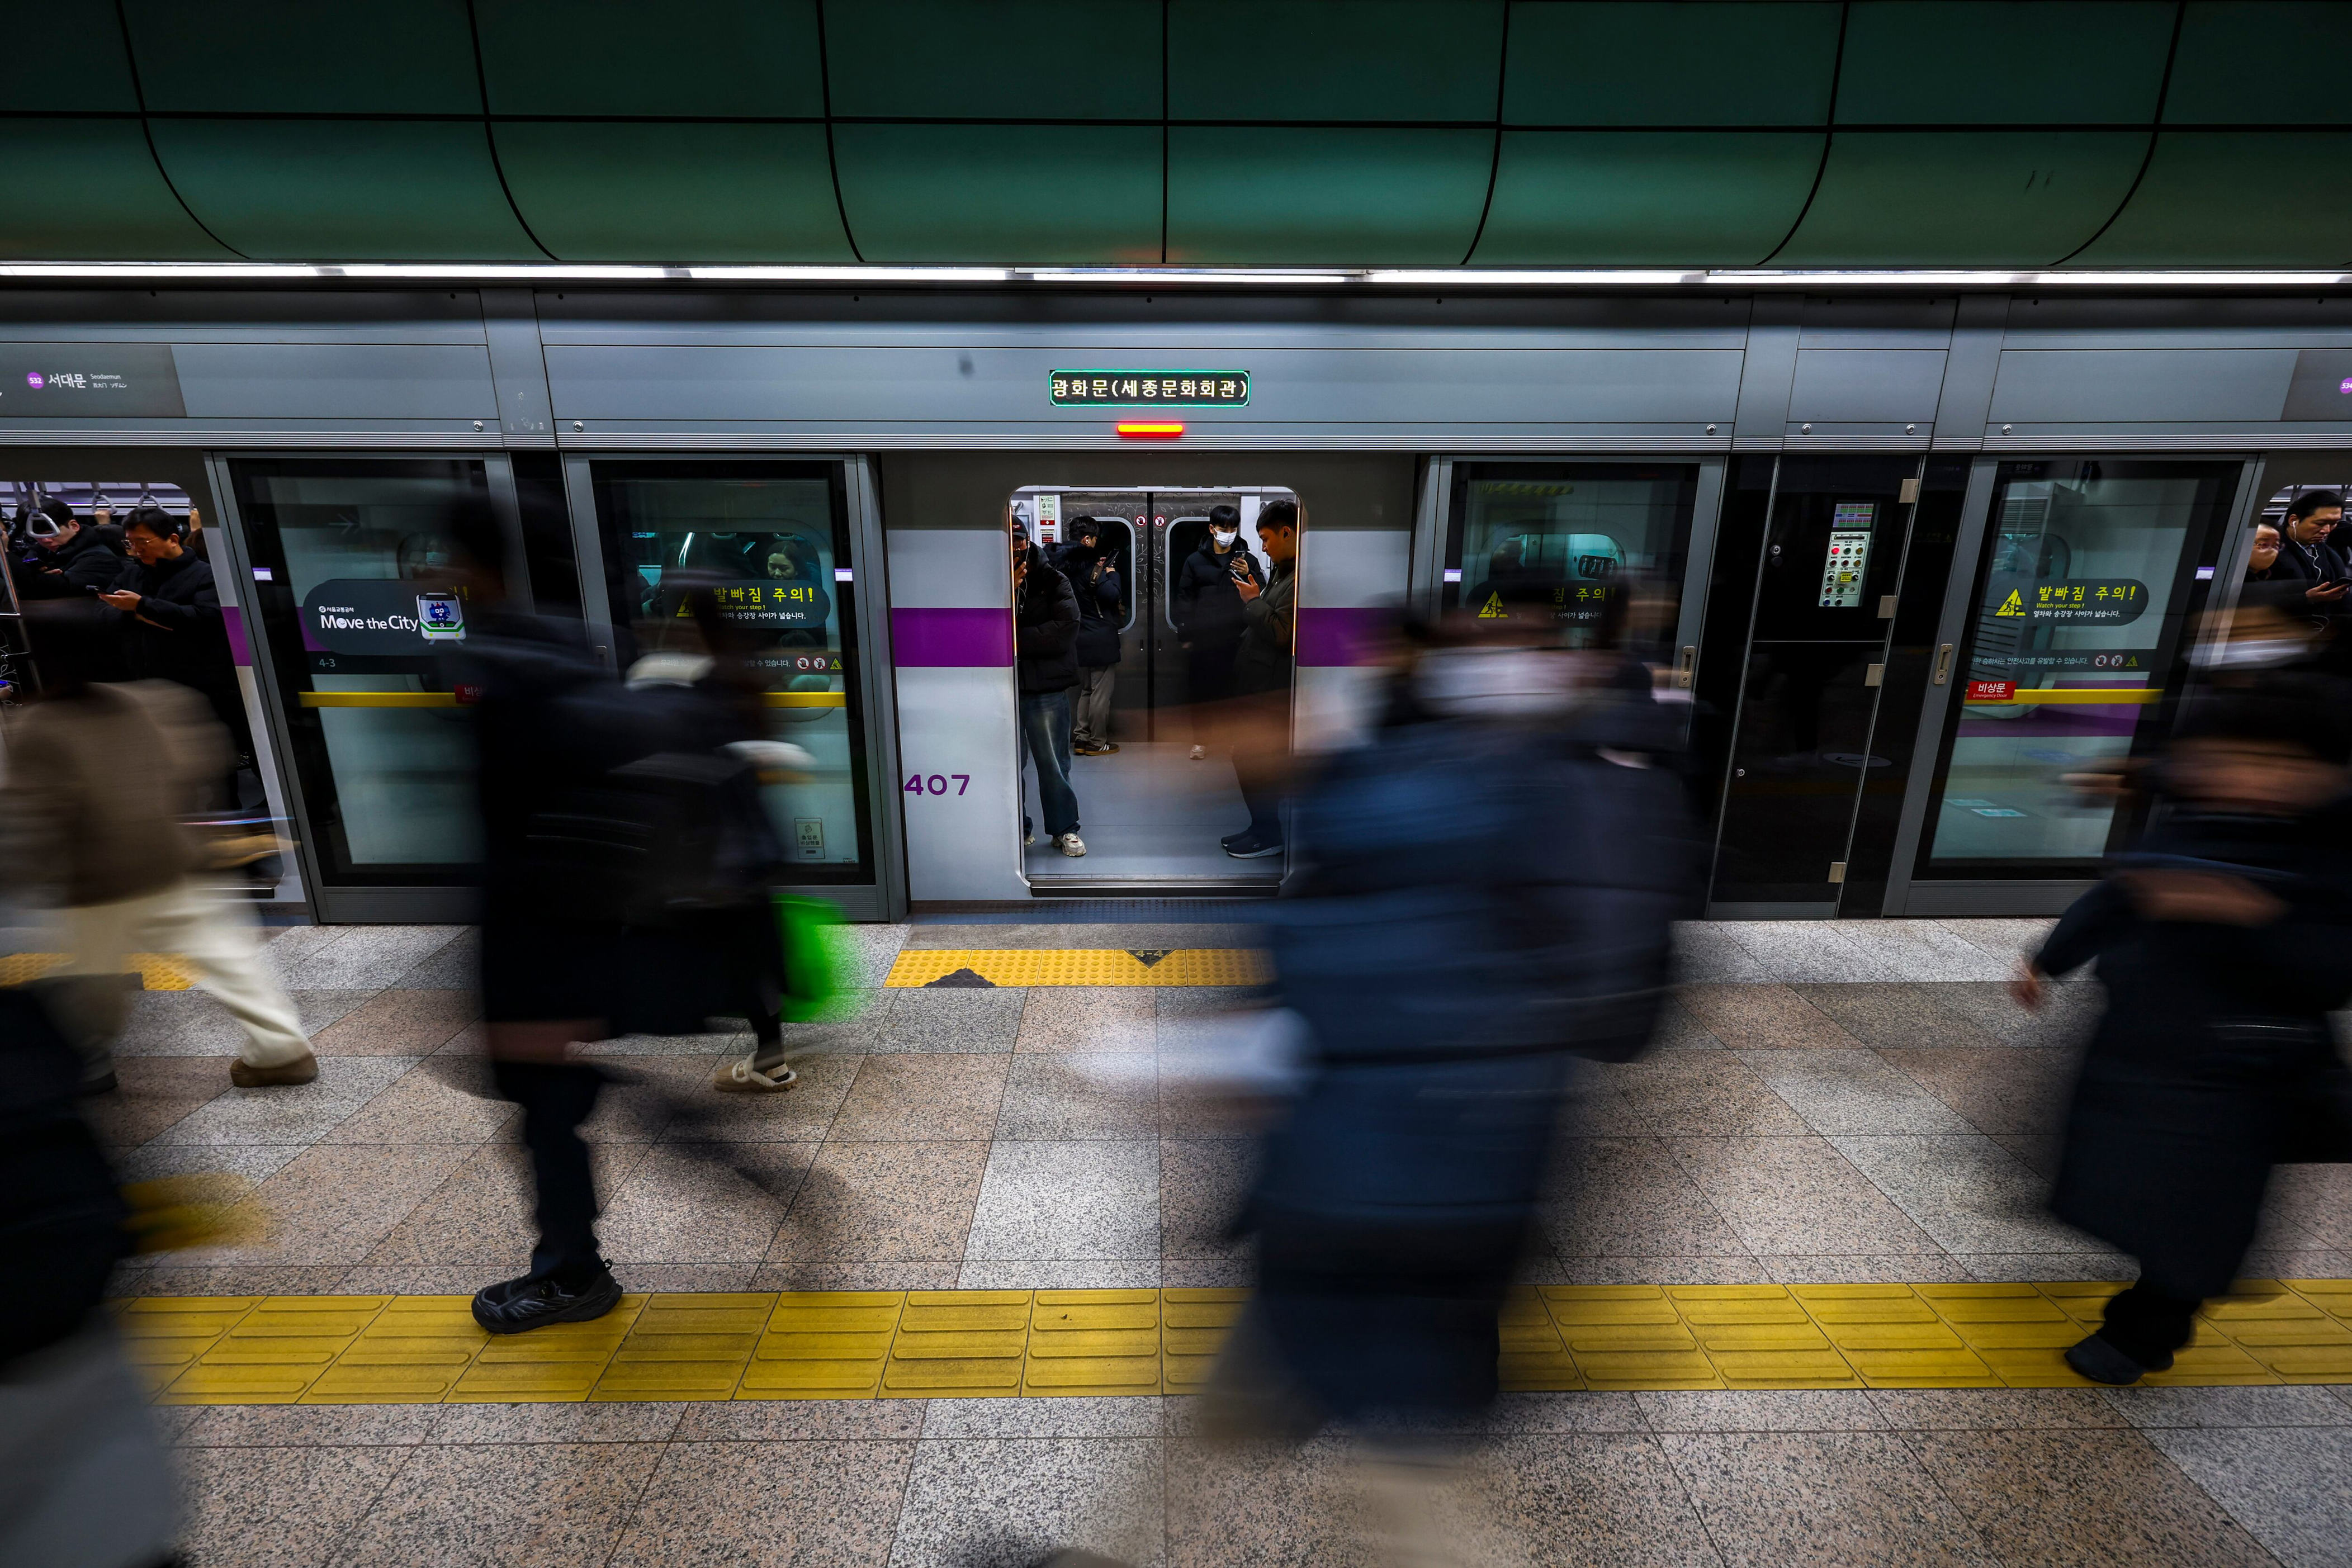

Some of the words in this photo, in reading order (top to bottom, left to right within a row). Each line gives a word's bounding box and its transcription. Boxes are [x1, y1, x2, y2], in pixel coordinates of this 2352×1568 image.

[49, 373, 87, 389] 서대문
[1052, 380, 1247, 398] 광화문(세종문화회관)
[713, 587, 761, 603] 발빠짐
[773, 588, 814, 603] 주의!
[2039, 586, 2085, 601] 발빠짐
[2095, 586, 2137, 601] 주의!
[320, 615, 364, 629] Move
[366, 617, 387, 629] the
[388, 615, 418, 632] City
[737, 612, 756, 620] 승강장
[758, 612, 778, 620] 사이가
[319, 659, 336, 668] 4-3
[464, 685, 484, 697] 비상
[1978, 683, 2006, 694] 비상문
[904, 774, 970, 795] 407
